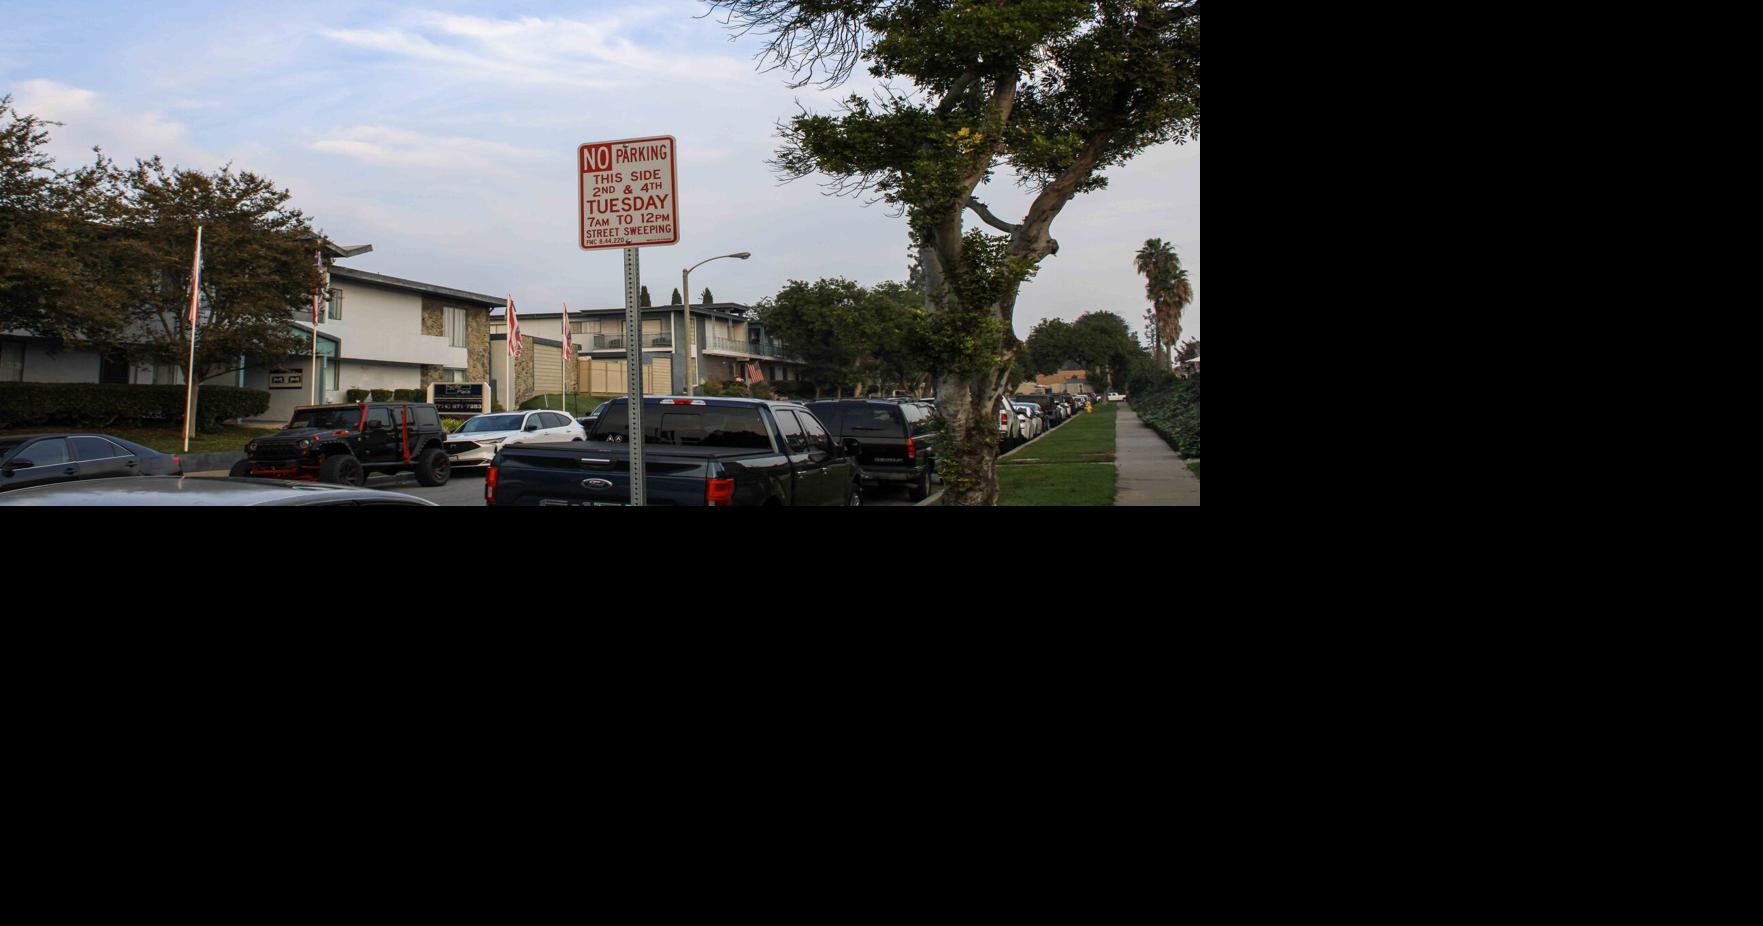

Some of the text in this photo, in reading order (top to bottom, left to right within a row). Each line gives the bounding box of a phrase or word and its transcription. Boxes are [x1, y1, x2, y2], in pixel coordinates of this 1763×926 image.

[583, 144, 667, 171] NO PARKING
[593, 169, 661, 185] THIS SIDE
[592, 182, 662, 197] 2ND & 4TH
[586, 194, 669, 214] TUESDAY
[587, 212, 670, 228] 7AM TO 12PM
[586, 224, 671, 239] STREET SWEEPING
